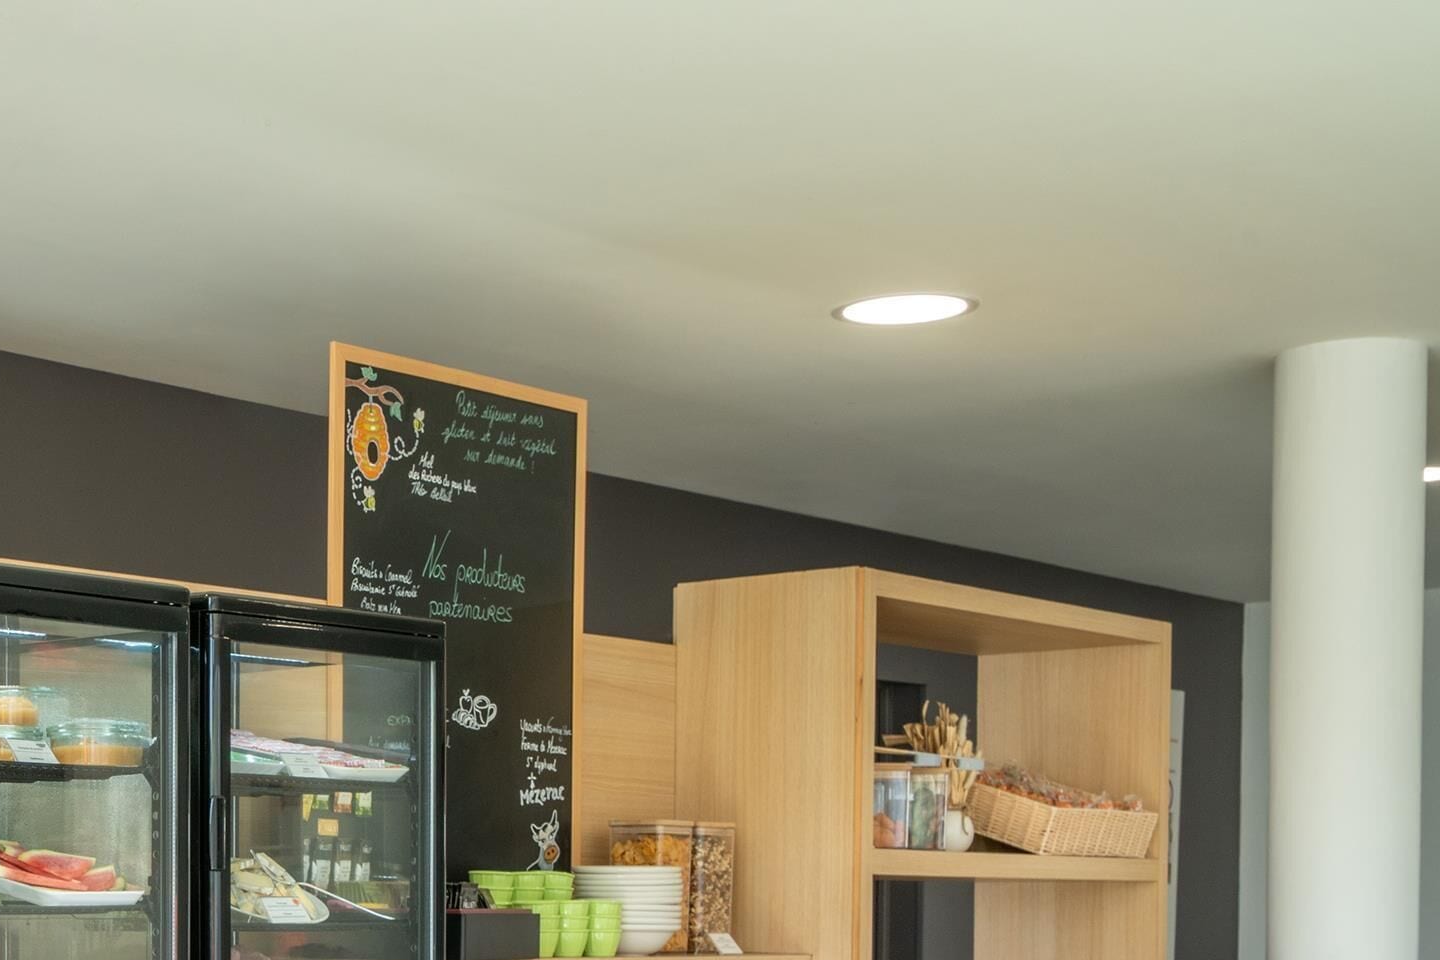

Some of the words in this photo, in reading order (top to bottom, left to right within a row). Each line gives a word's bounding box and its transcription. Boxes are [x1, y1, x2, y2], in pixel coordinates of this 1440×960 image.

[521, 414, 543, 428] sans
[481, 430, 491, 442] et
[422, 530, 451, 580] Nos
[453, 548, 526, 603] producteurs
[428, 600, 513, 622] partenaires
